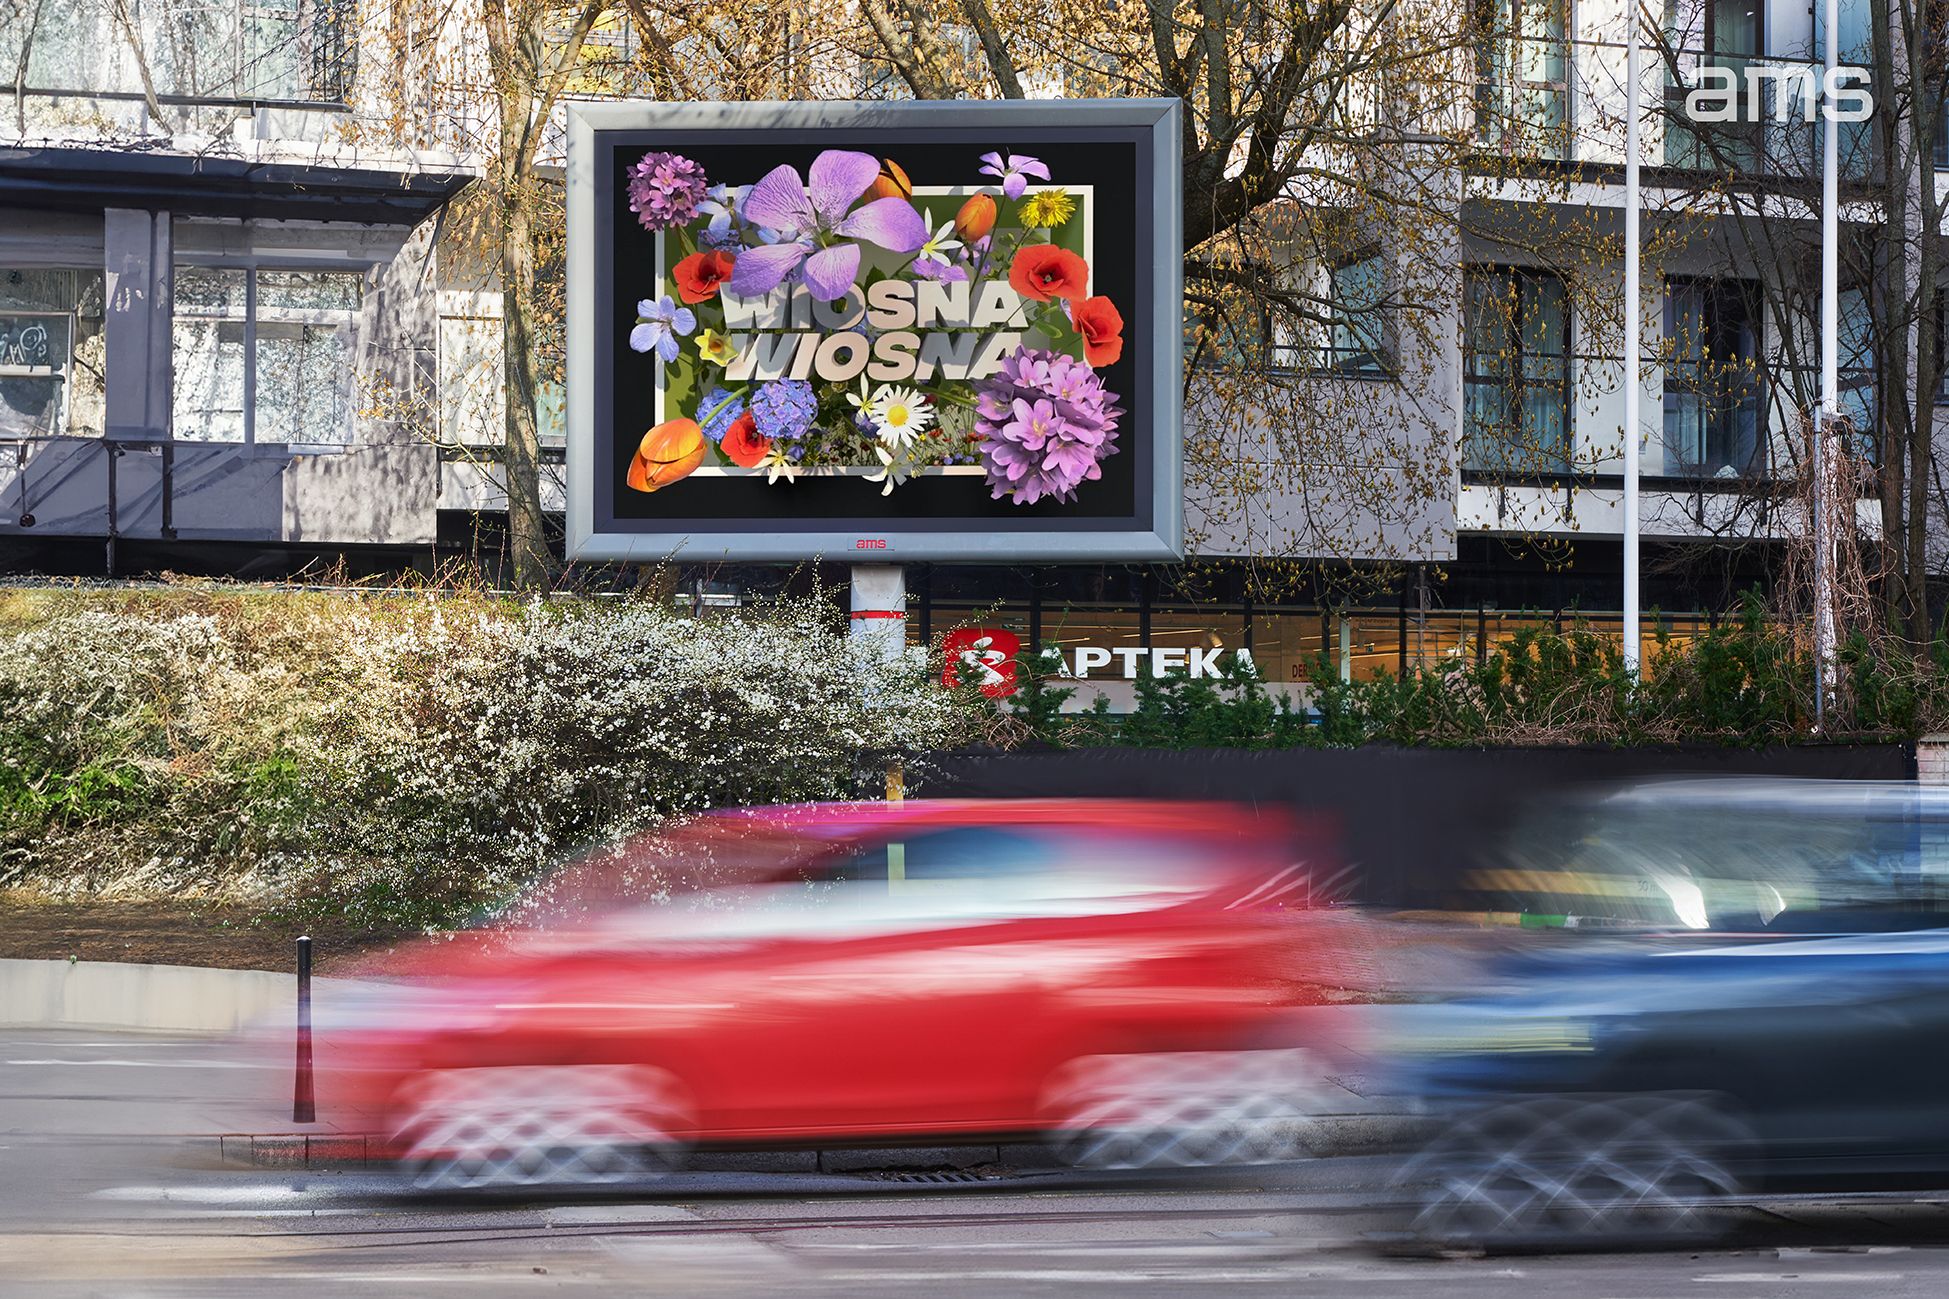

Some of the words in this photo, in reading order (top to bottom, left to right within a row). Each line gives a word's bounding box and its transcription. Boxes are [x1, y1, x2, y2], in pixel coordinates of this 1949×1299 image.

[719, 280, 1029, 329] WIOSNA
[724, 331, 1022, 381] WIOSNA
[856, 539, 887, 549] ams
[1040, 647, 1259, 679] APTEKA
